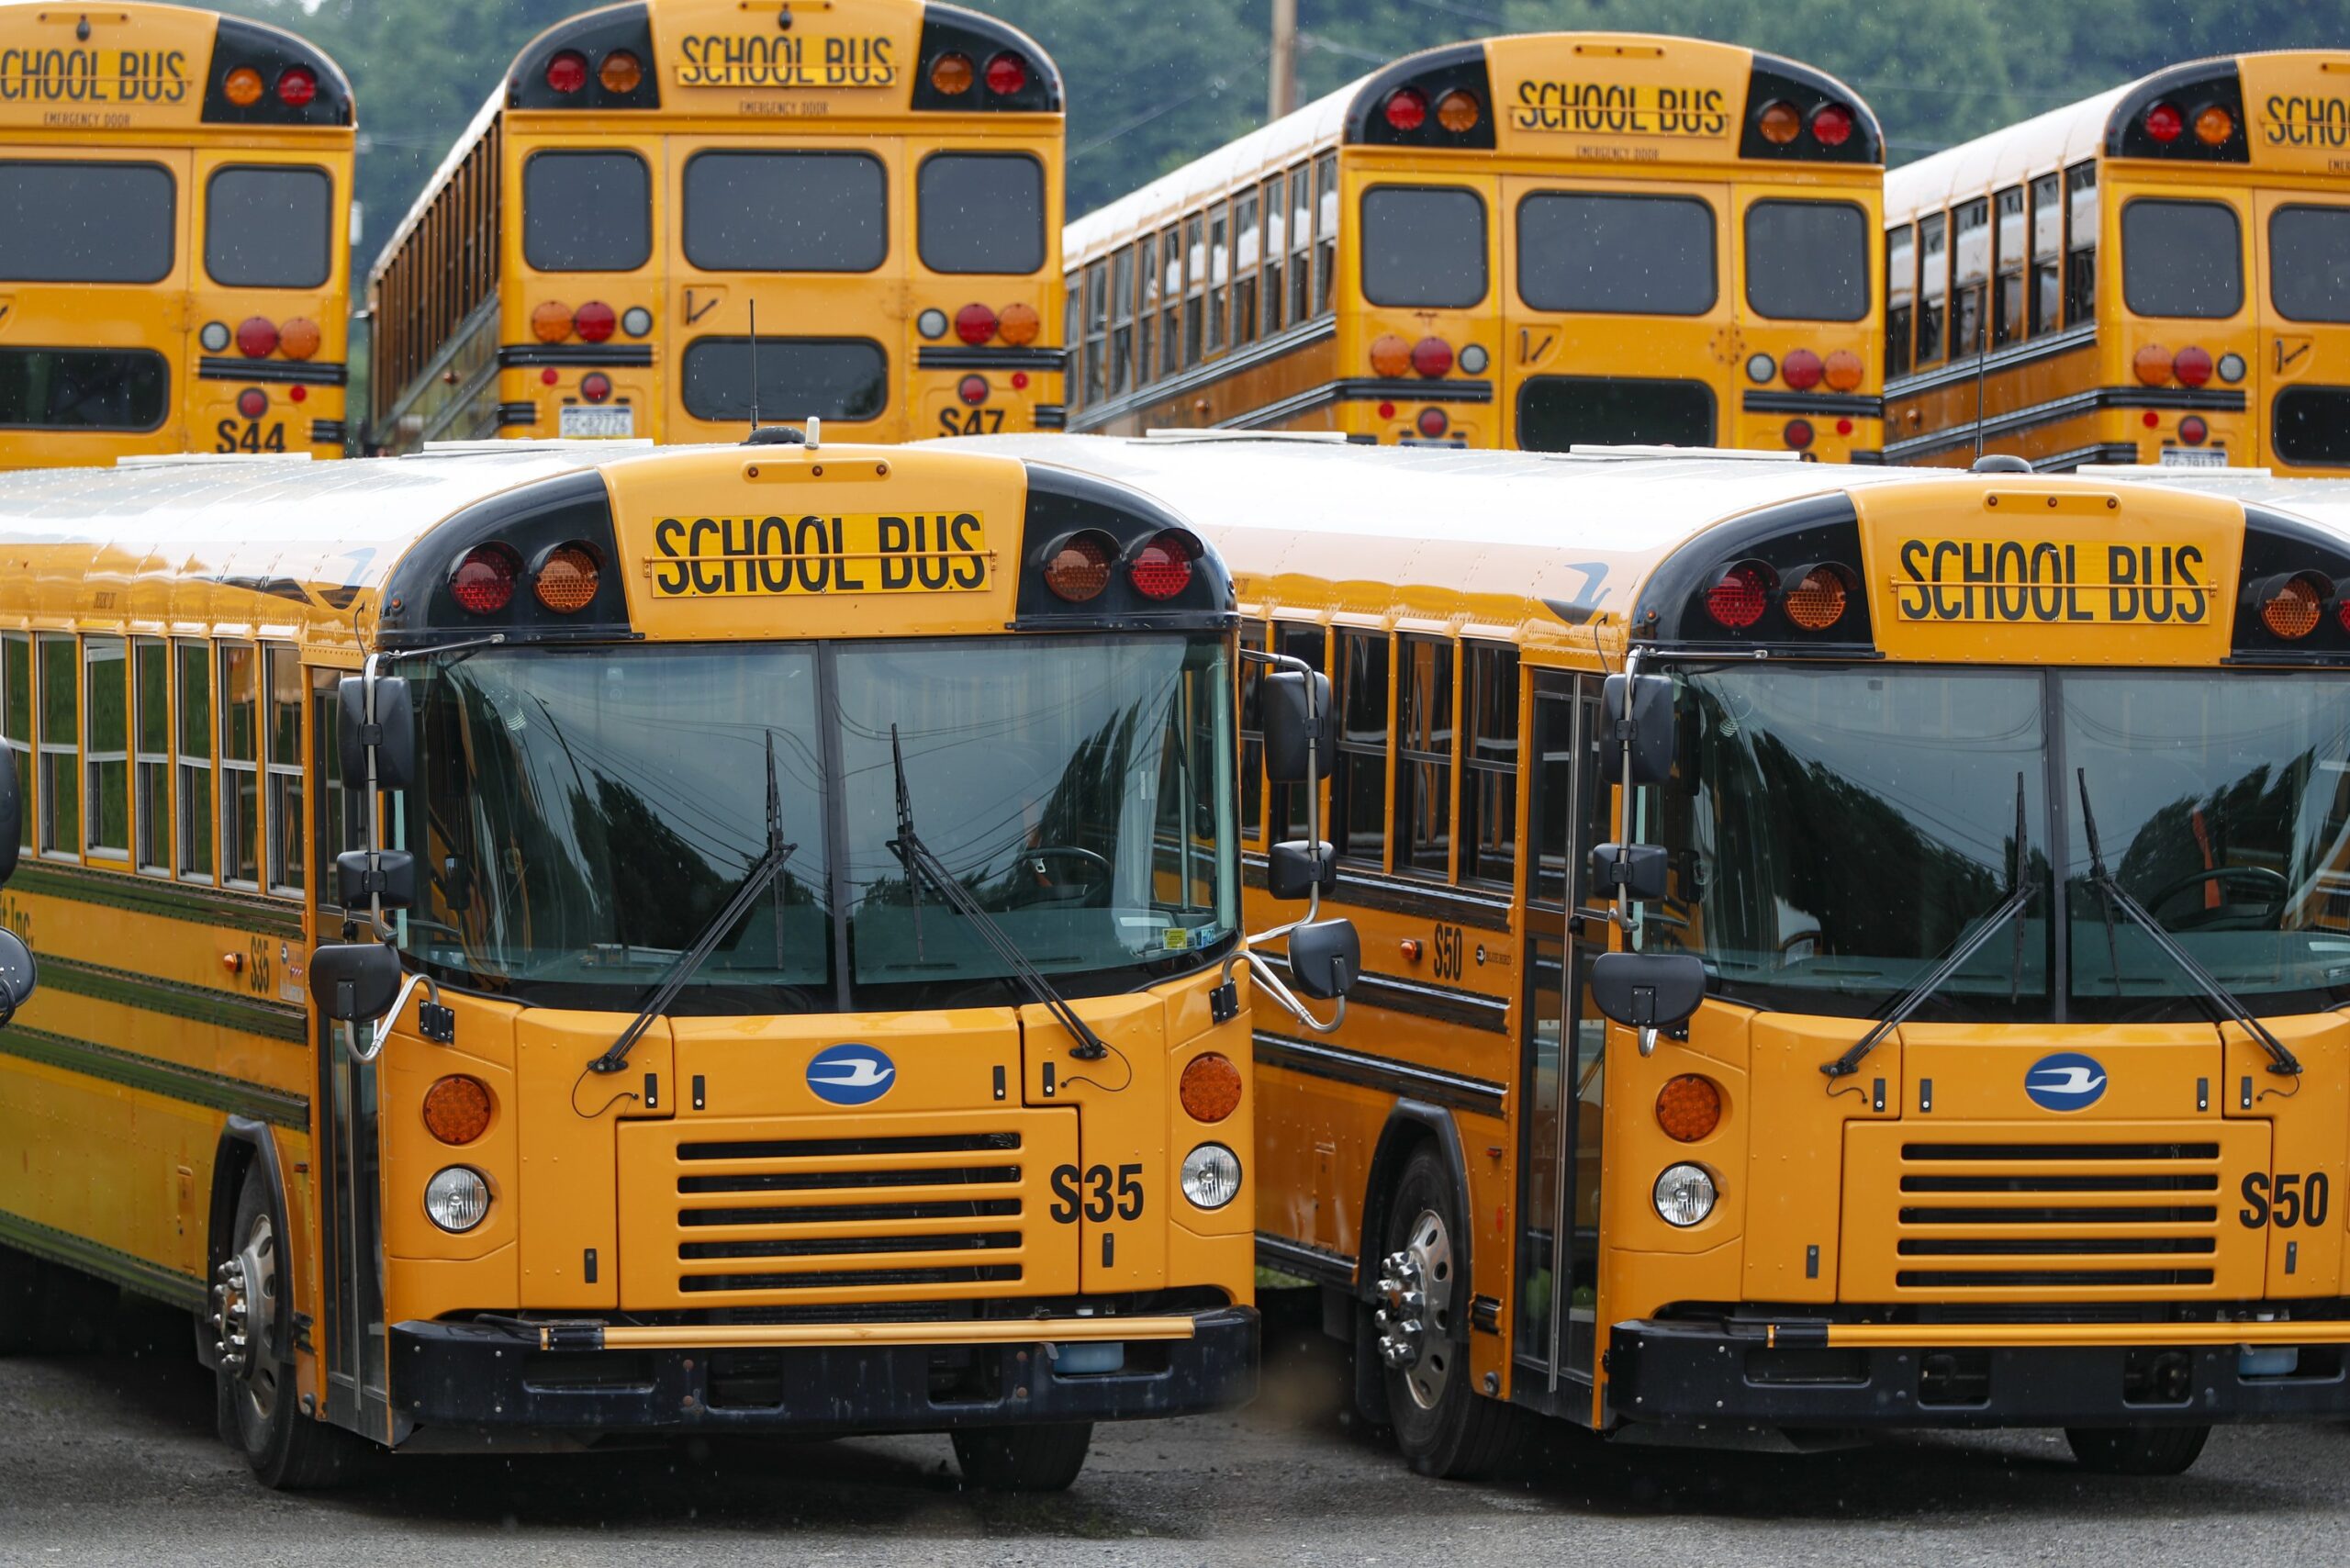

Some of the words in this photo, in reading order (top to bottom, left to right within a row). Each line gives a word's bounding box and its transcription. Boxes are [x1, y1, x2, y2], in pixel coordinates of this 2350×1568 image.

[0, 50, 107, 100] CHOOL
[119, 50, 185, 102] BUS
[682, 36, 814, 84] SCHOOL
[826, 38, 893, 84] BUS
[44, 111, 99, 127] EMERGENCY
[105, 113, 130, 129] DOOR
[1518, 81, 1647, 132] SCHOOL
[1659, 89, 1725, 133] BUS
[2266, 95, 2350, 148] SCHO
[216, 420, 285, 454] S44
[938, 408, 1004, 437] S47
[655, 516, 864, 595] SCHOOL
[878, 513, 986, 590] BUS
[1900, 540, 2094, 621] SCHOOL
[2108, 545, 2206, 622] BUS
[251, 935, 270, 994] S35
[1434, 923, 1462, 981] S50
[1050, 1163, 1144, 1224] S35
[2239, 1171, 2329, 1229] S50
